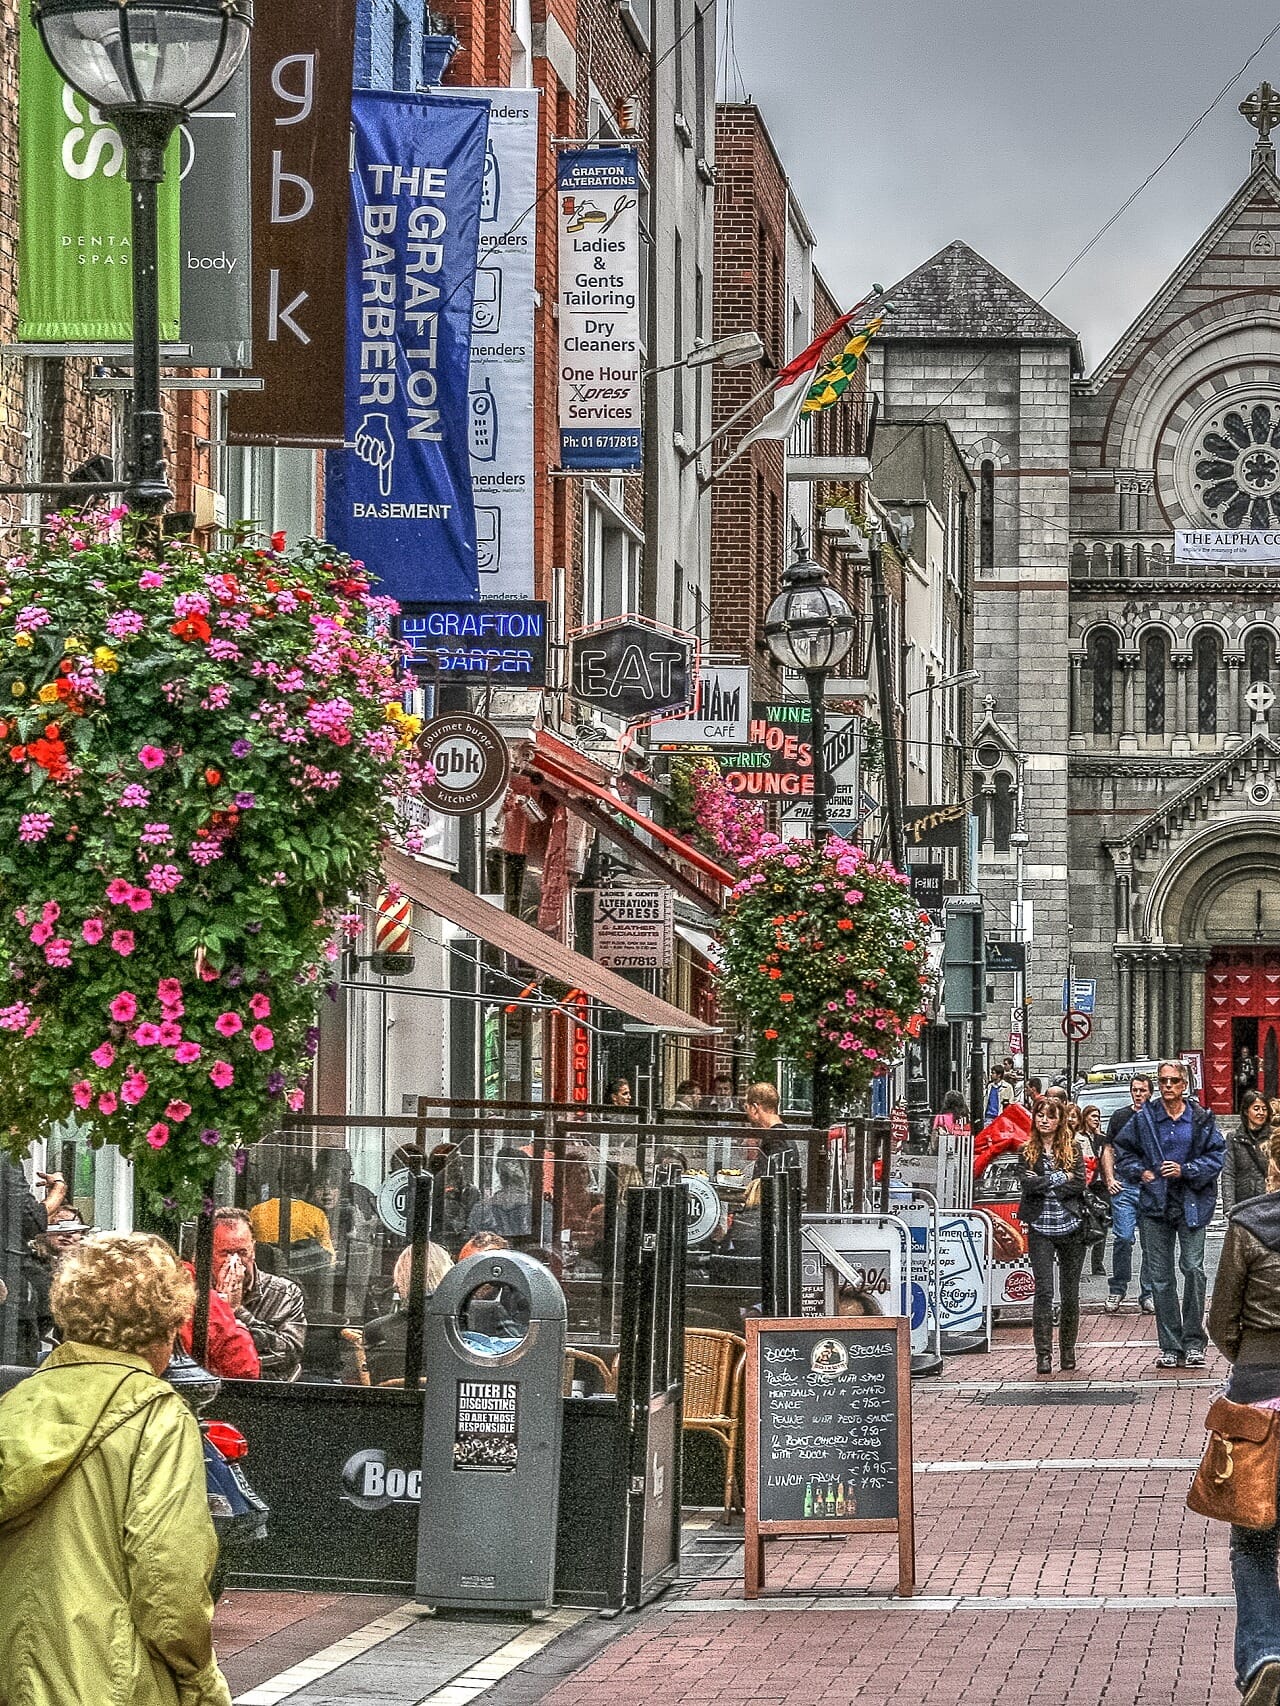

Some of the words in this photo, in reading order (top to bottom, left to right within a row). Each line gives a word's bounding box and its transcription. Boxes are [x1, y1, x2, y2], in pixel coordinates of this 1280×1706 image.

[572, 167, 624, 176] GRAFTON
[367, 164, 448, 198] THE
[561, 177, 635, 187] ALTERATIONS
[573, 238, 625, 252] Ladies
[187, 251, 236, 273] body
[594, 256, 606, 270] &
[575, 274, 624, 288] Gents
[359, 205, 397, 406] BARBER
[563, 291, 635, 308] Tailoring
[404, 205, 447, 442] GRAFTON
[585, 320, 614, 337] Dry
[564, 337, 635, 351] Cleaners
[562, 367, 594, 381] One
[600, 367, 638, 381] Hour
[569, 384, 630, 402] Xpress
[569, 405, 632, 418] Services
[563, 436, 579, 447] Ph:
[582, 436, 592, 447] 01
[596, 436, 638, 448] 6717813
[353, 503, 451, 519] BASEMENT
[1183, 534, 1211, 545] THE
[1215, 533, 1260, 545] ALPHA
[428, 613, 540, 636] GRAFTON
[580, 644, 682, 699] EAT
[766, 706, 812, 723] WINE
[423, 724, 462, 748] gourmet
[465, 723, 495, 750] burger
[704, 723, 735, 737] CAFÉ
[435, 748, 479, 777] gbk
[437, 791, 478, 803] kitchen
[599, 900, 659, 908] ALTERATIONS
[614, 956, 657, 966] 6717813
[849, 1343, 892, 1356] SPECIALS
[460, 1383, 500, 1398] LITTER
[503, 1384, 516, 1398] IS
[460, 1398, 515, 1410] DISGUSTING
[460, 1413, 470, 1421] SO
[471, 1413, 487, 1422] ARE
[488, 1414, 515, 1422] THOSE
[459, 1422, 515, 1433] RESPONSIBLE
[768, 1474, 803, 1486] LUNCH
